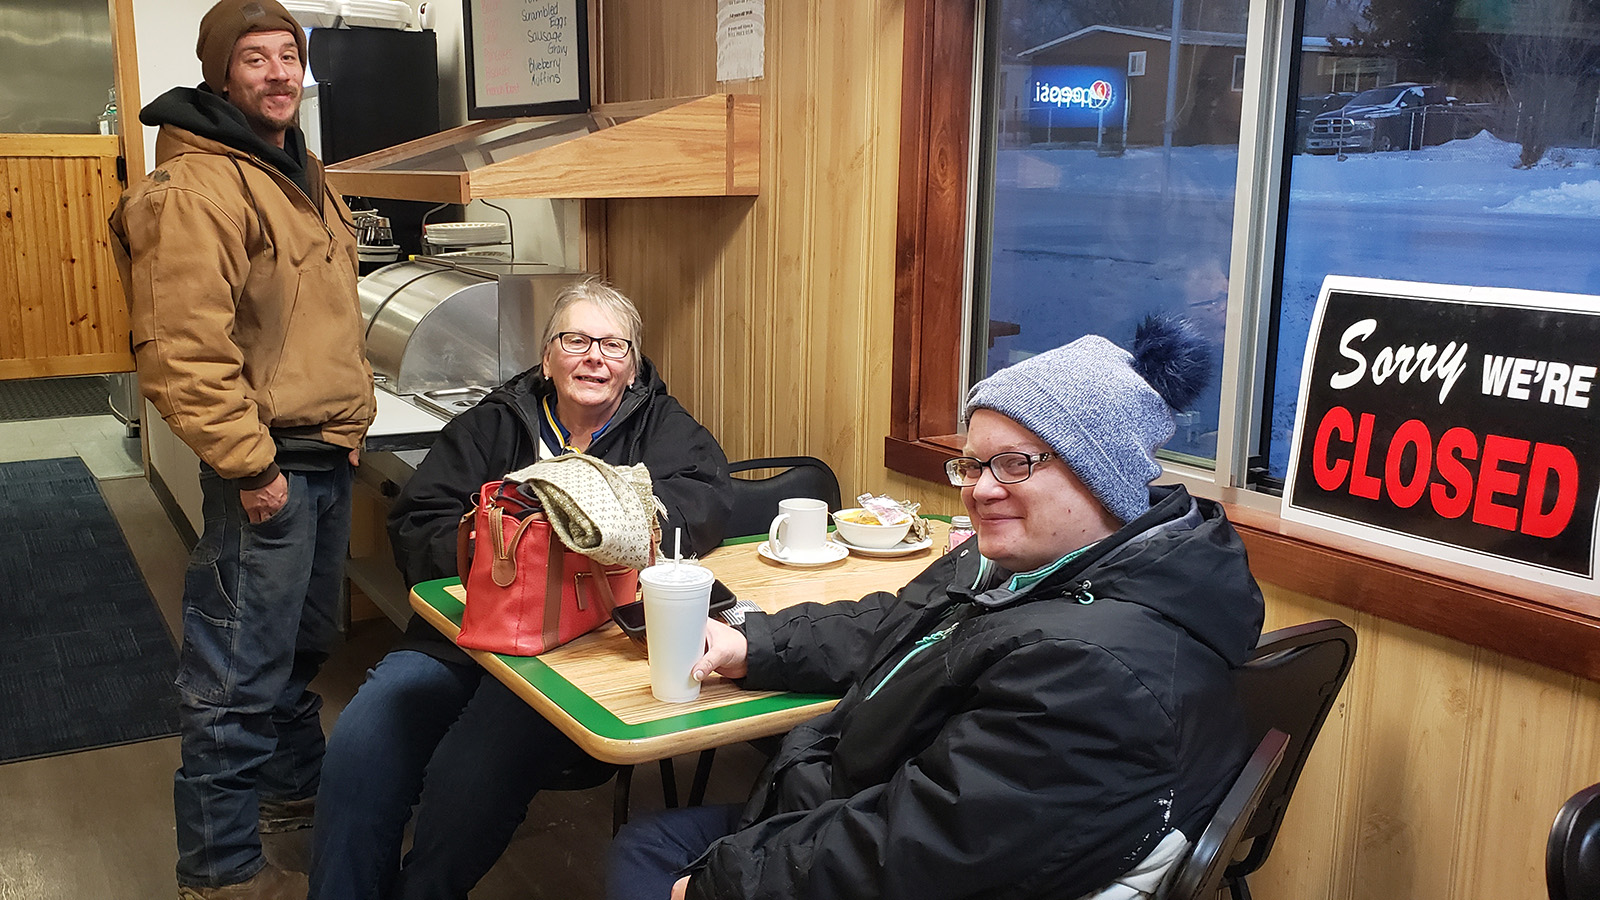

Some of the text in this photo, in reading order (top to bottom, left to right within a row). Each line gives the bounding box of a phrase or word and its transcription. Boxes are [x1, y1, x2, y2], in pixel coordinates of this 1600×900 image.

[522, 2, 559, 21] Scrambled
[549, 16, 567, 29] Eggs
[527, 30, 562, 43] Sausage
[548, 43, 568, 56] Gravy
[528, 57, 561, 73] Blueberry
[531, 72, 561, 86] Muffins
[1330, 318, 1597, 409] Sorry WE'RE
[1313, 406, 1579, 539] CLOSED
